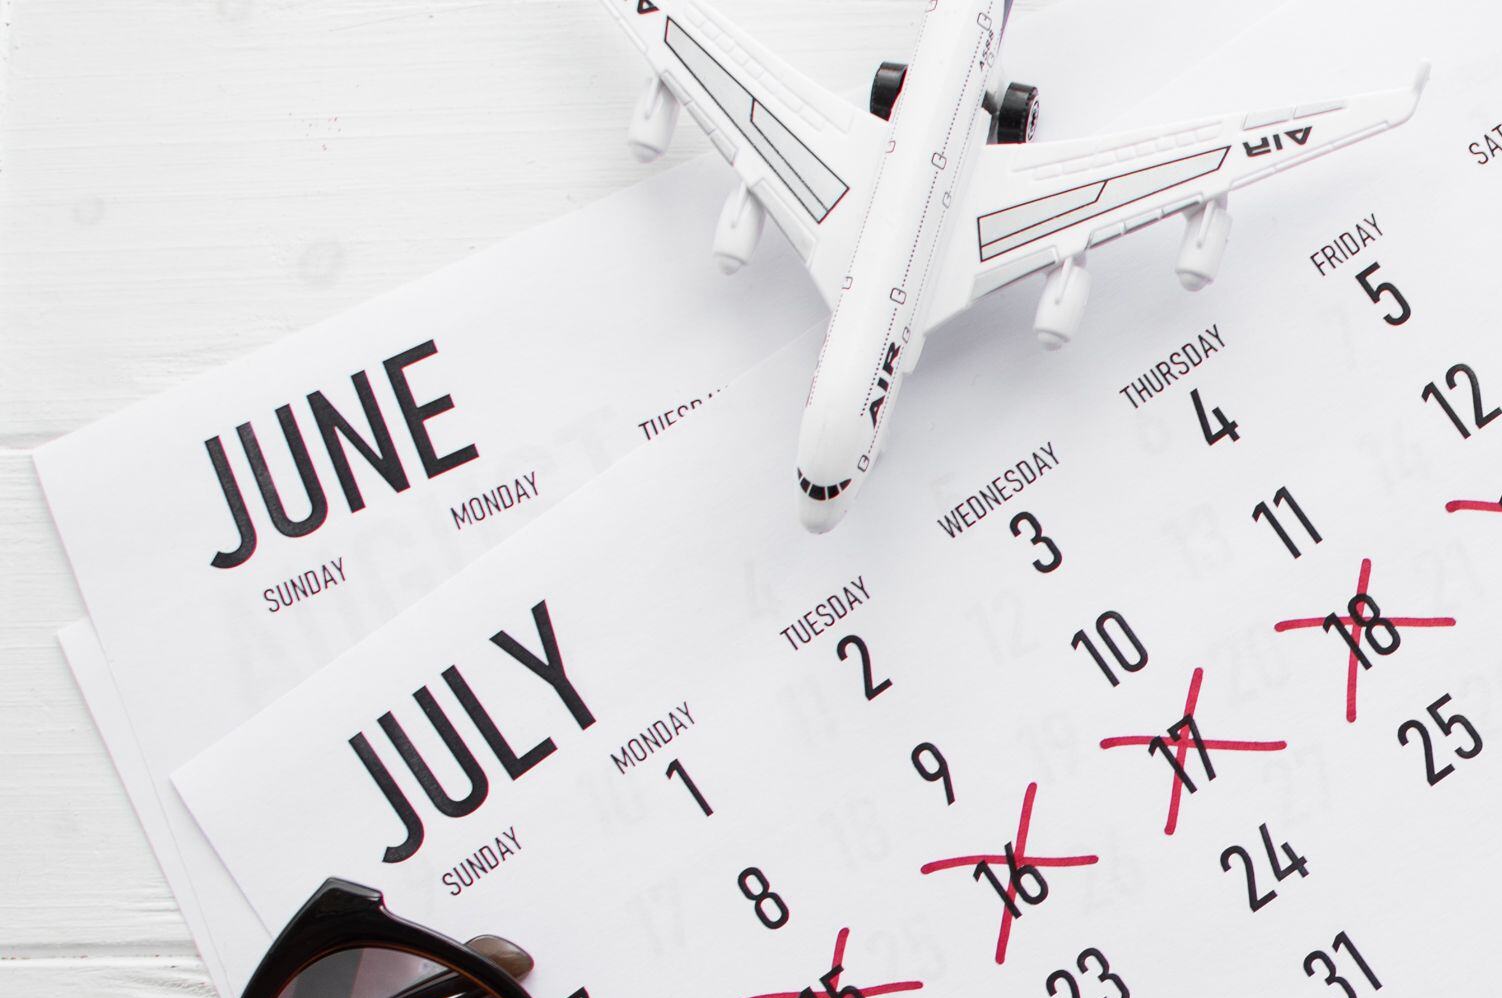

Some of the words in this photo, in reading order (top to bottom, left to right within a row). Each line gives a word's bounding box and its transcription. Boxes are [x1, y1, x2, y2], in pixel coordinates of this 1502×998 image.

[1243, 126, 1312, 158] AIR
[205, 339, 480, 570] JUNE
[867, 341, 902, 430] AIR
[264, 557, 345, 612] SUNDAY
[451, 471, 541, 531] MONDAY
[442, 827, 521, 895] SUNDAY
[611, 701, 695, 775] MONDAY
[780, 576, 870, 651] TUESDAY
[937, 442, 1060, 538] WEDNESDAY
[1119, 324, 1226, 410] THURSDAY
[1310, 213, 1383, 277] FRIDAY
[666, 759, 713, 816] 1
[837, 635, 892, 701] 2
[1010, 512, 1062, 573] 3
[1190, 388, 1240, 445] 4
[1355, 262, 1411, 325] 5
[738, 867, 788, 929] 8
[911, 742, 955, 805] 9
[1071, 611, 1148, 687] 10
[1252, 487, 1322, 559] 11
[1422, 364, 1502, 439] 12
[348, 600, 597, 864] JULY
[973, 842, 1048, 919] 16
[1148, 715, 1216, 794] 17
[1323, 593, 1400, 670] 18
[1220, 823, 1309, 912] 24
[1398, 693, 1483, 786] 25
